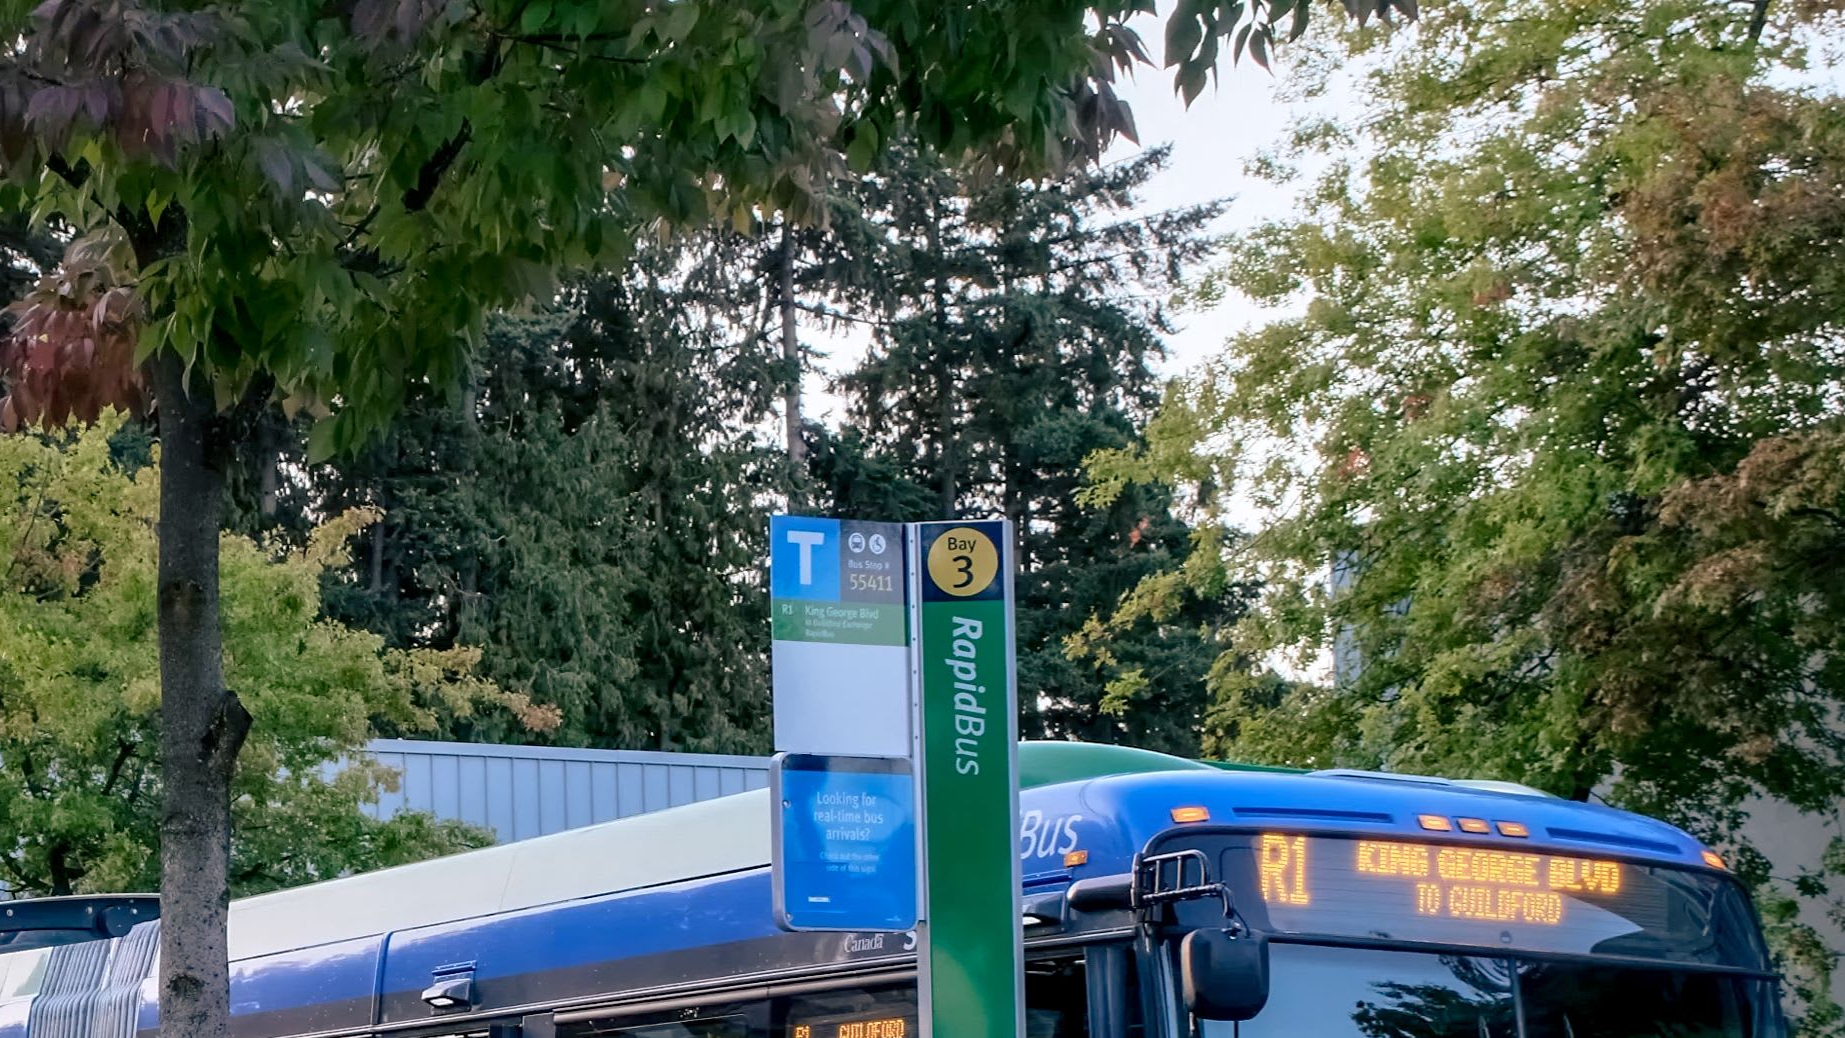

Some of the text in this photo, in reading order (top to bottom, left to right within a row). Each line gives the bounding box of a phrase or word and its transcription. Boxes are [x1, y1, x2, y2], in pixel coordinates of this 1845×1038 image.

[948, 537, 977, 553] Bay
[787, 530, 825, 585] T
[848, 560, 862, 569] Bus
[865, 560, 883, 571] Stop
[952, 555, 974, 589] 3
[850, 573, 893, 592] 55411
[781, 604, 879, 619] R1 King George Blvd
[944, 616, 987, 775] RapidBus
[817, 792, 877, 809] Looking for
[814, 811, 883, 824] real-time bus
[826, 828, 870, 841] arrivals?
[1260, 834, 1620, 904] R1 KING GEORGE BLVD
[1417, 883, 1563, 924] TO GUILDFORD
[844, 934, 885, 952] Canada
